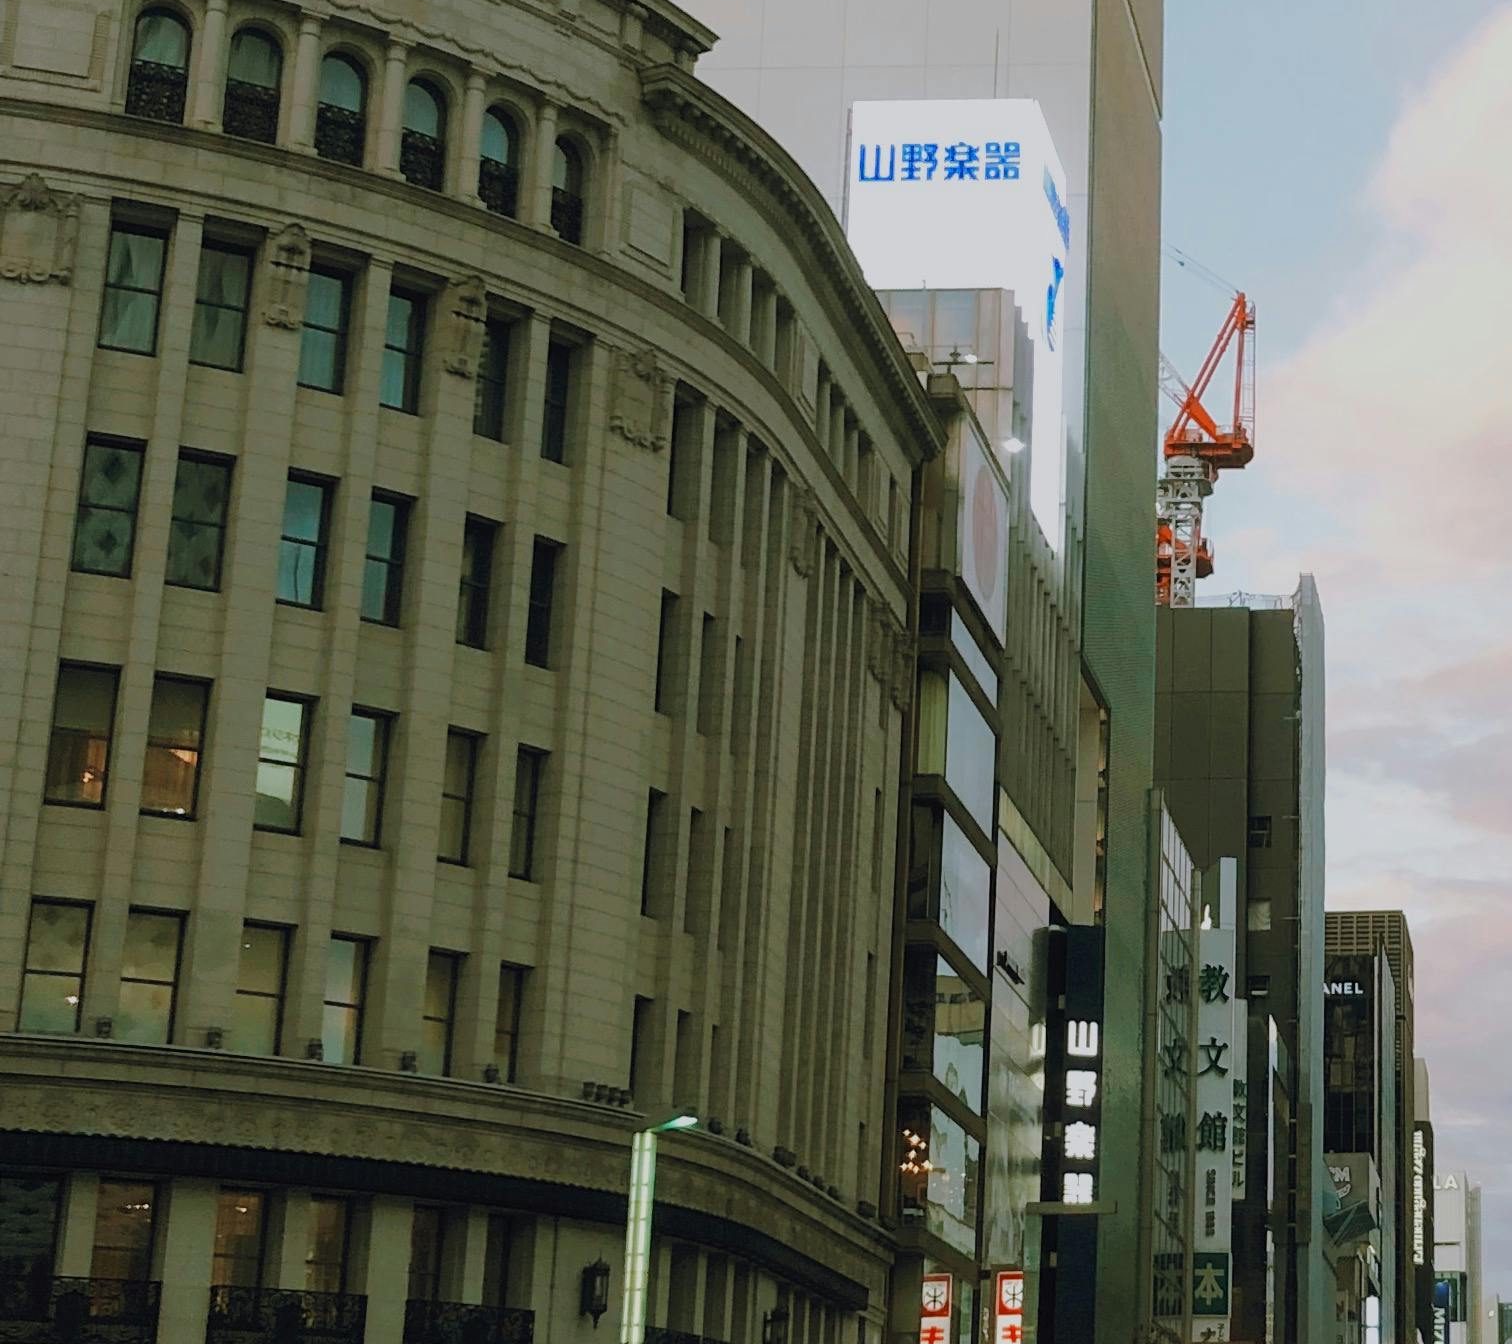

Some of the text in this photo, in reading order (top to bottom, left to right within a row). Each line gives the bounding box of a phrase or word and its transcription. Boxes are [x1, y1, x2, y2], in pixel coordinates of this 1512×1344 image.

[859, 142, 1020, 181] 山野楽器
[1196, 963, 1230, 1151] 教文館
[1194, 1262, 1225, 1306] 本
